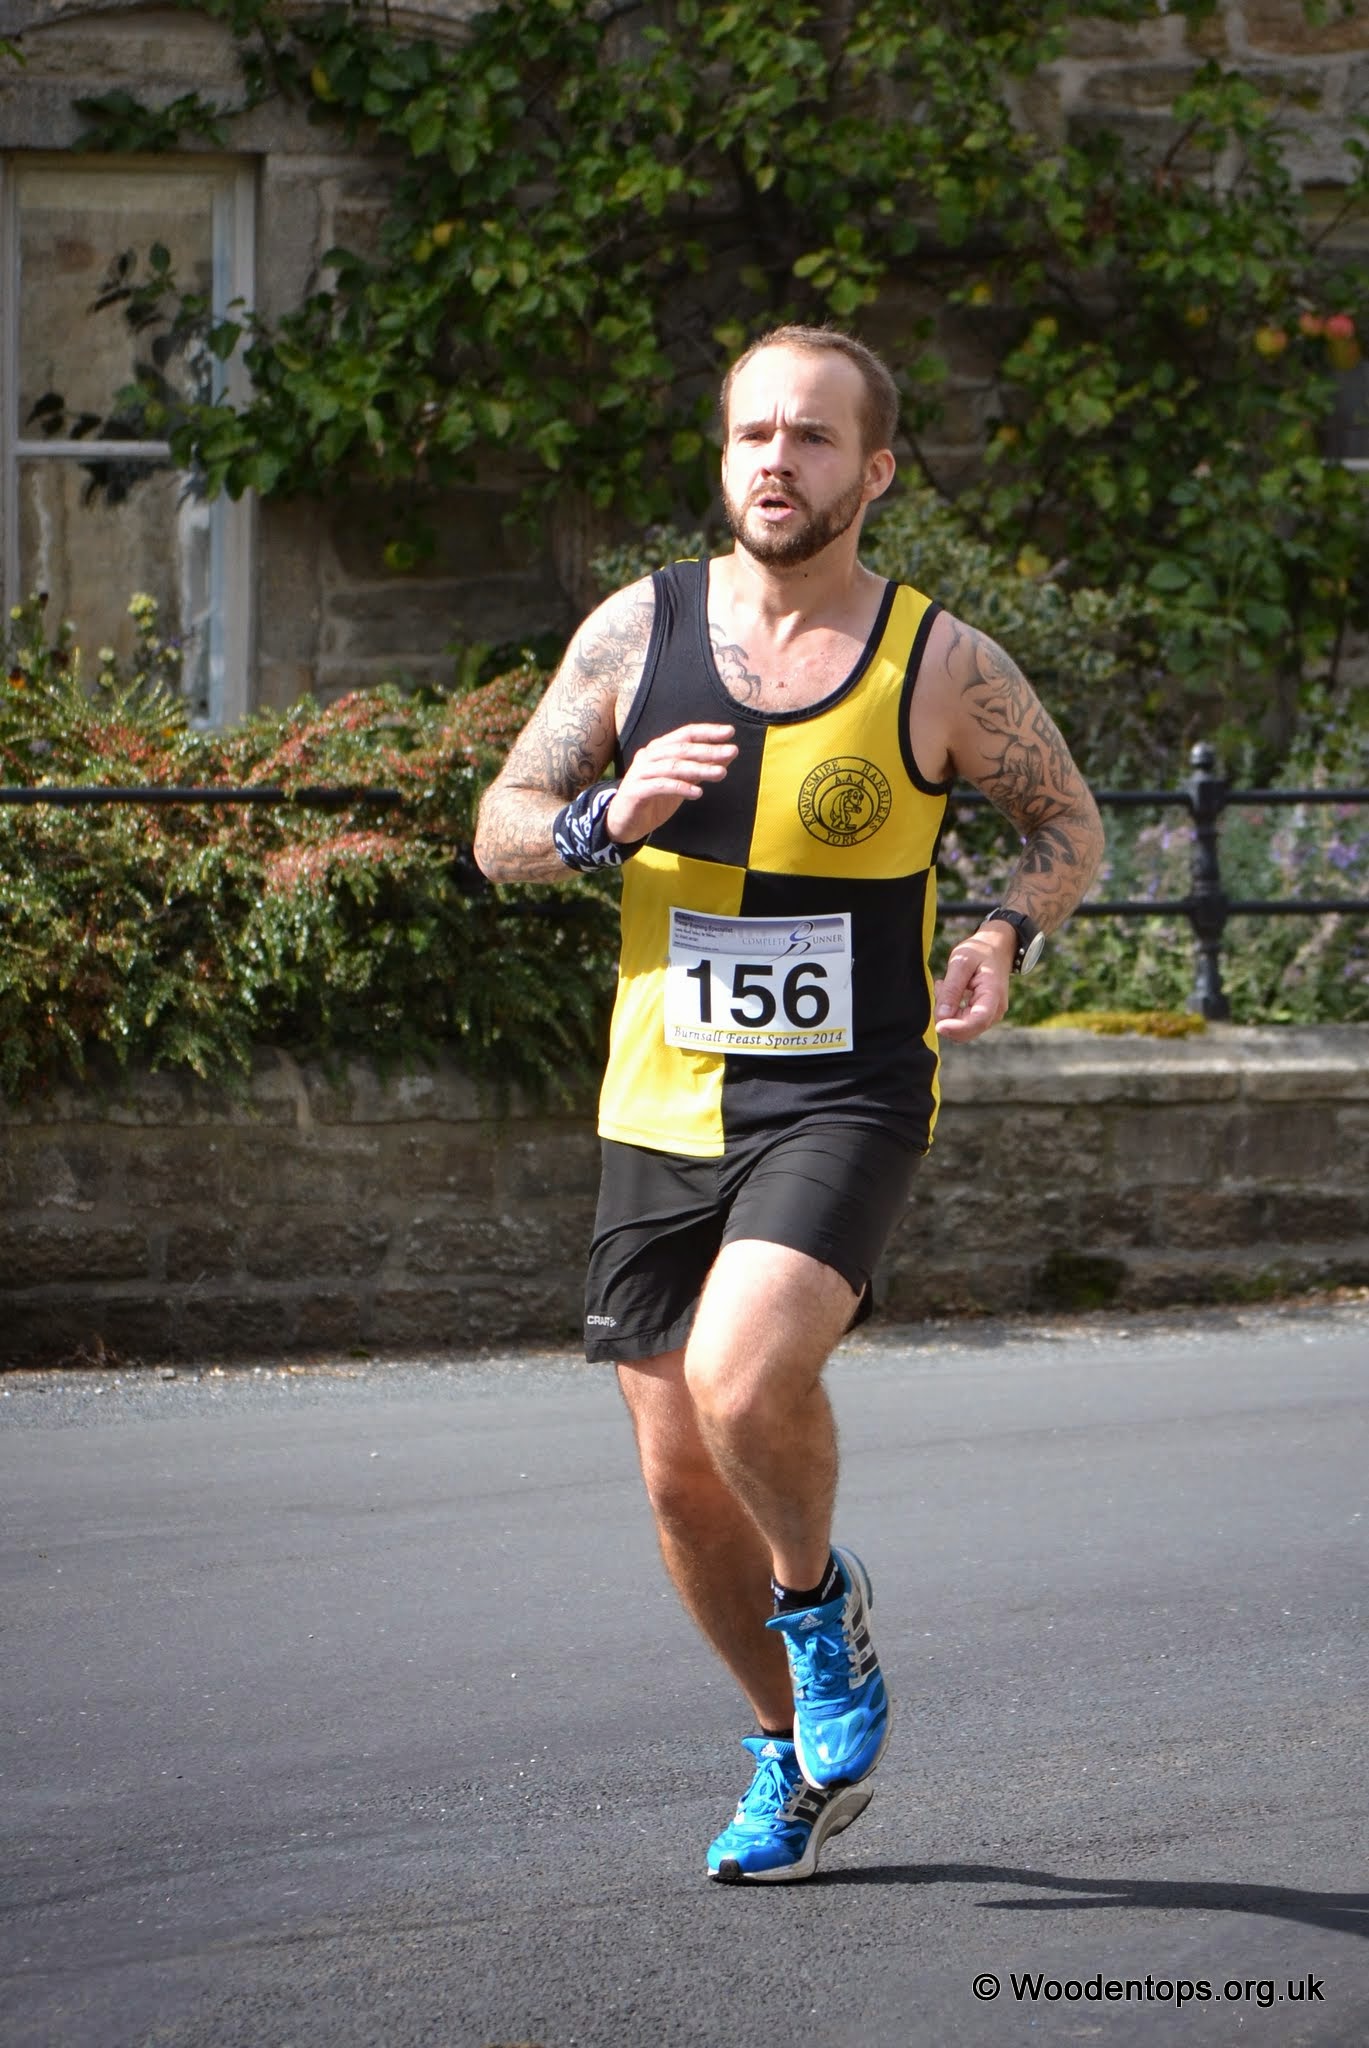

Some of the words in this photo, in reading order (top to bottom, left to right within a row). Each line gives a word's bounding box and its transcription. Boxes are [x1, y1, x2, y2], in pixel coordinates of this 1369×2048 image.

[801, 760, 840, 826] KNAVESMIRE
[862, 763, 890, 831] HARRIERS
[826, 832, 858, 844] YORK
[742, 937, 787, 946] COMPLETE
[687, 959, 830, 1029] 156
[674, 1026, 724, 1043] Burnsall
[727, 1032, 761, 1045] Feast
[765, 1034, 808, 1049] Sports
[812, 1031, 842, 1045] 2014
